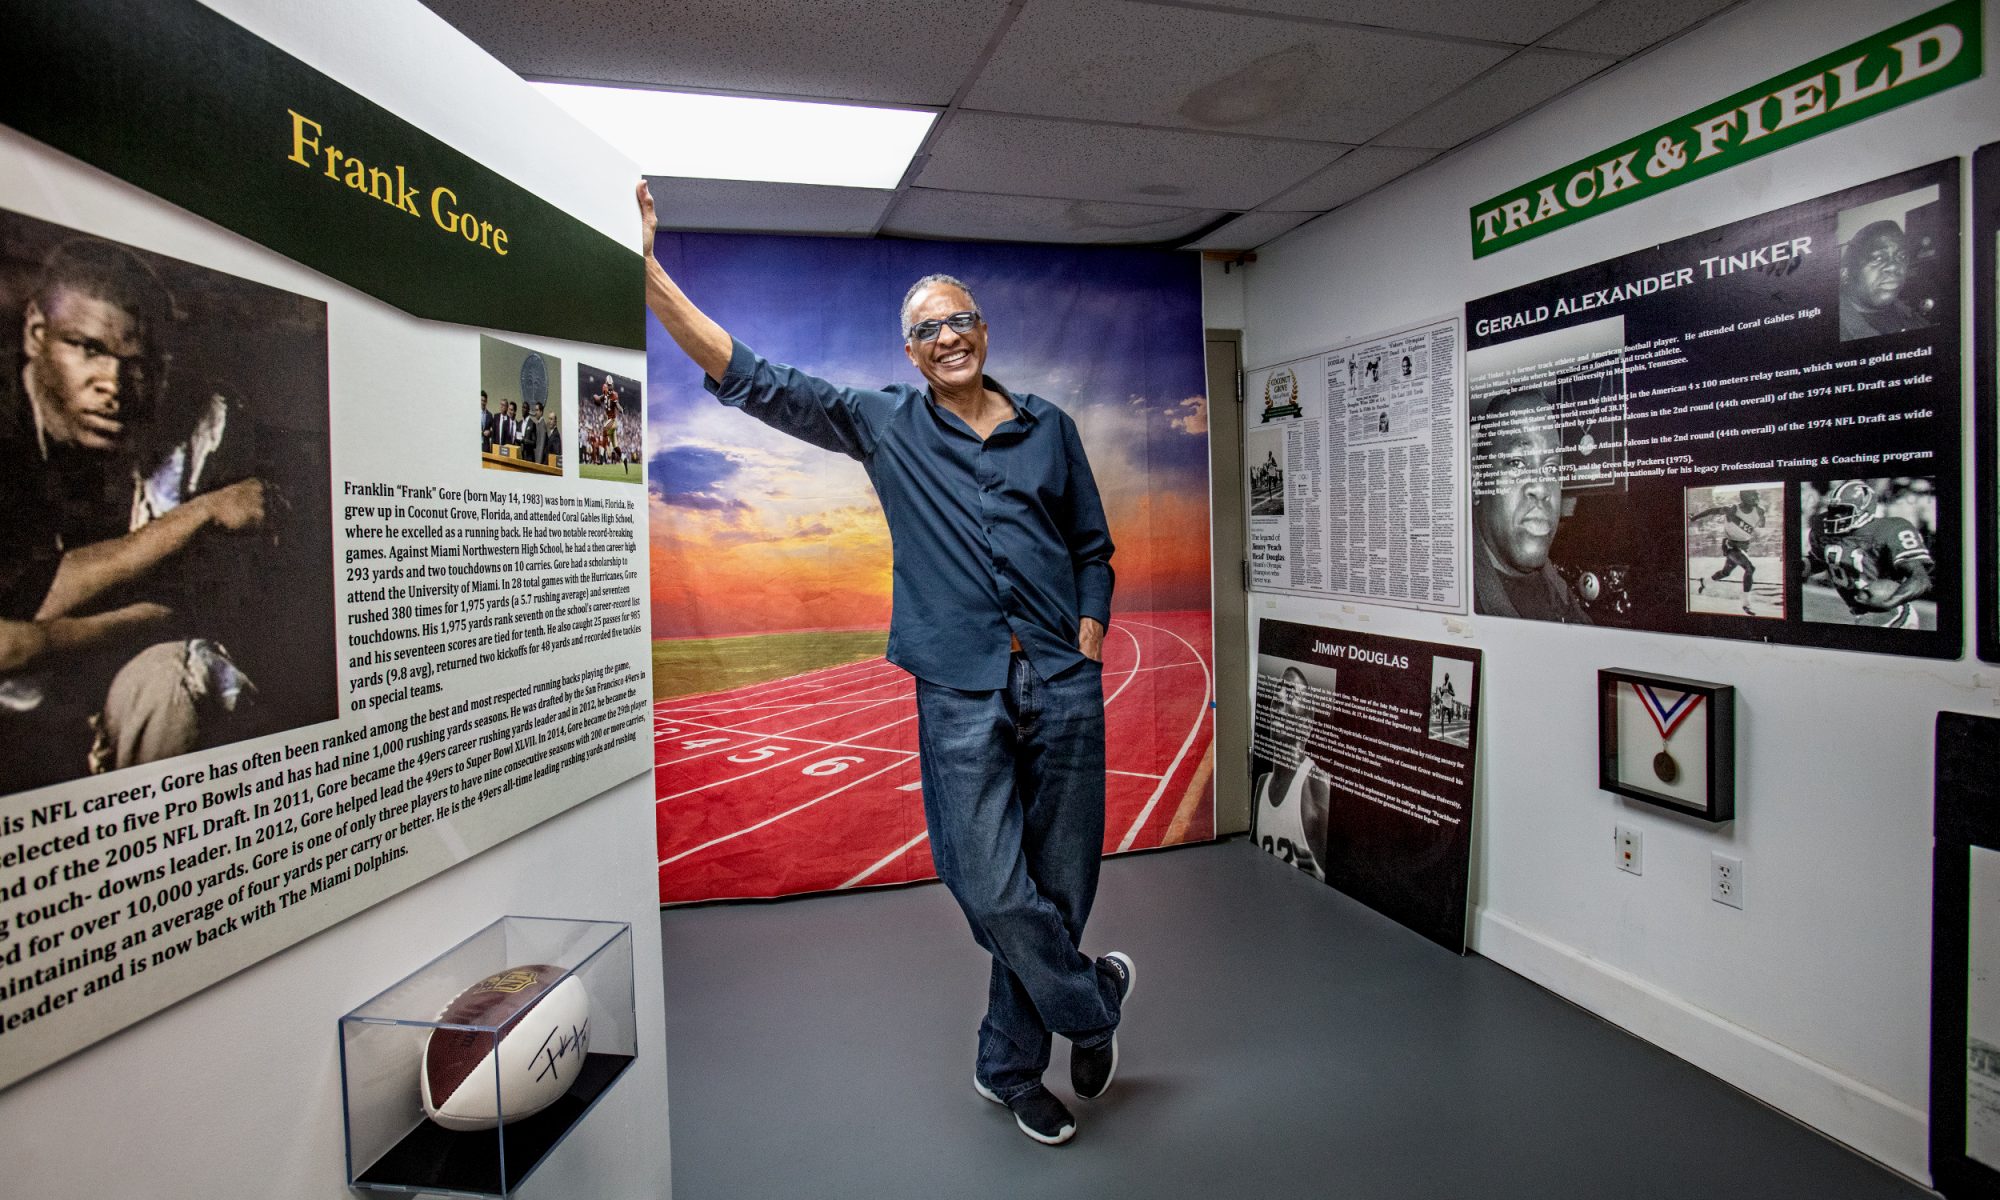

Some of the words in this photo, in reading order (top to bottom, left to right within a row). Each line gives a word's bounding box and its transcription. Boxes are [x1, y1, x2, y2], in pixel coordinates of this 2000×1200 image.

[1476, 148, 1642, 244] TRACK
[1645, 136, 1688, 178] &
[1693, 23, 1964, 163] FIELD
[287, 109, 421, 217] Frank
[431, 186, 509, 256] Gore
[1475, 306, 1549, 336] GERALD
[1553, 267, 1694, 318] ALEXANDER
[1699, 236, 1813, 280] TINKER
[1684, 332, 1695, 340] He
[1697, 323, 1734, 337] attended
[1737, 318, 1760, 330] Coral
[1763, 313, 1794, 324] Gables
[1798, 307, 1820, 318] High
[1638, 389, 1650, 397] the
[1651, 385, 1686, 395] American
[1687, 382, 1693, 390] 4
[1702, 379, 1717, 388] 100
[1719, 376, 1748, 385] meters
[1749, 372, 1773, 381] relay
[1774, 368, 1801, 377] team,
[1802, 361, 1832, 372] which
[1834, 359, 1857, 368] won
[1868, 352, 1892, 365] gold
[1895, 346, 1931, 359] medal
[1666, 466, 1678, 474] for
[1680, 465, 1692, 473] his
[1693, 465, 1719, 474] legacy
[1721, 459, 1774, 470] Professional
[1776, 457, 1817, 467] Training
[1820, 456, 1828, 464] &
[1831, 453, 1879, 463] Coaching
[1882, 451, 1932, 462] program
[344, 481, 394, 496] Franklin
[438, 487, 461, 500] Gore
[463, 489, 487, 503] (born
[489, 491, 506, 505] May
[508, 492, 520, 504] 14,
[522, 493, 543, 507] 1983)
[544, 497, 558, 505] was
[559, 495, 575, 506] born
[576, 497, 583, 506] in
[584, 497, 604, 508] Miami,
[604, 498, 626, 509] Florida.
[626, 500, 634, 509] He
[1312, 640, 1346, 659] JIMMY
[1348, 646, 1409, 669] DOUGLAS
[31, 801, 76, 827] NFL
[83, 784, 155, 813] career,
[161, 771, 204, 792] Gore
[208, 762, 237, 780] has
[241, 751, 281, 770] often
[284, 741, 318, 759] been
[322, 725, 367, 749] ranked
[370, 718, 408, 737] among
[410, 712, 426, 726] the
[428, 706, 449, 721] best
[451, 699, 468, 715] and
[470, 695, 492, 710] most
[493, 684, 531, 704] respected
[532, 679, 561, 693] running
[561, 673, 580, 685] backs
[581, 668, 603, 683] playing
[604, 664, 613, 674] the
[614, 661, 631, 676] game,
[95, 823, 117, 839] to
[123, 811, 159, 832] five
[165, 800, 197, 819] Pro
[202, 782, 251, 808] Bowls
[255, 771, 283, 792] and
[287, 767, 311, 783] has
[315, 755, 339, 775] had
[342, 750, 369, 767] nine
[372, 738, 403, 758] 1,000
[406, 729, 445, 748] rushing
[446, 719, 472, 739] yards
[474, 711, 508, 728] seasons.
[510, 705, 520, 717] He
[522, 702, 536, 713] was
[538, 692, 563, 708] drafted
[564, 691, 572, 703] by
[573, 688, 584, 698] the
[585, 685, 596, 695] San
[596, 678, 623, 691] Francisco
[624, 673, 639, 683] 49ers
[640, 670, 645, 679] in
[681, 738, 731, 750] 4
[727, 745, 791, 763] 5
[801, 756, 865, 777] 6
[0, 987, 78, 1034] leader
[83, 963, 124, 996] and
[130, 958, 146, 975] is
[152, 938, 191, 965] now
[196, 917, 237, 945] back
[240, 900, 275, 925] with
[278, 889, 306, 908] The
[310, 866, 350, 895] Miami
[354, 846, 408, 876] Dolphins.
